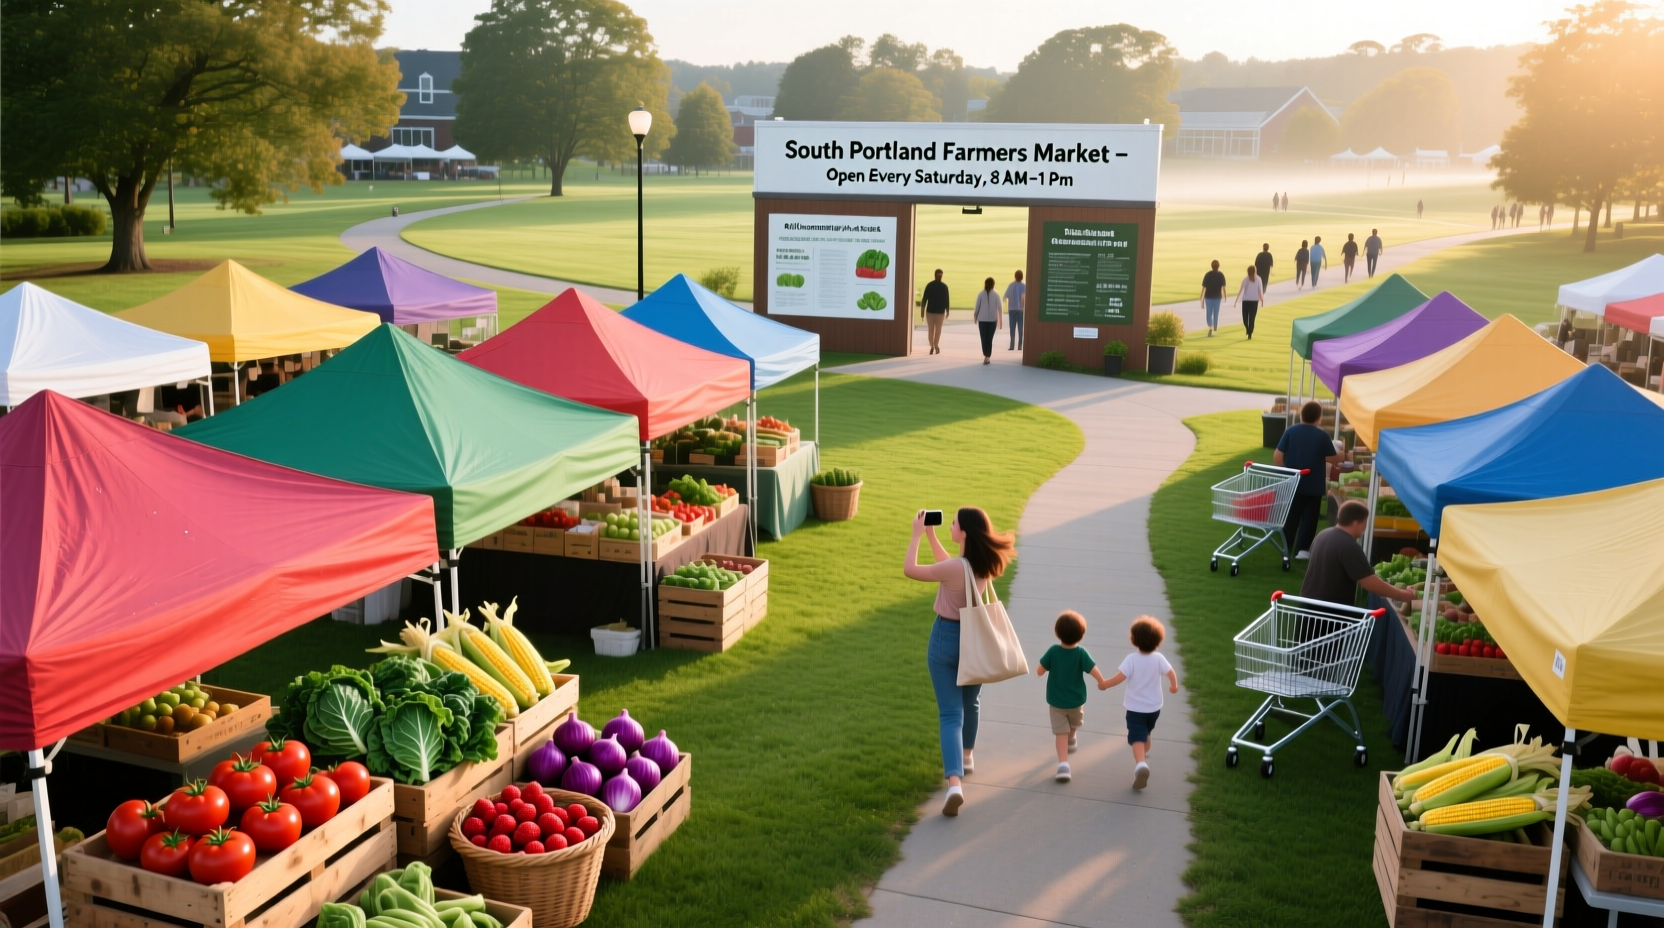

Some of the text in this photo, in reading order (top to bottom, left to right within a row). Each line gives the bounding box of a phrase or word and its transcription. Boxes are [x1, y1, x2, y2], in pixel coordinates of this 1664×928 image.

[785, 139, 844, 160] South
[849, 140, 937, 161] Portland
[943, 141, 1028, 163] Farmers
[1033, 142, 1110, 164] Market
[826, 167, 865, 187] Open
[868, 168, 912, 187] Every
[914, 168, 987, 189] Saturday,
[1048, 171, 1074, 187] Pm
